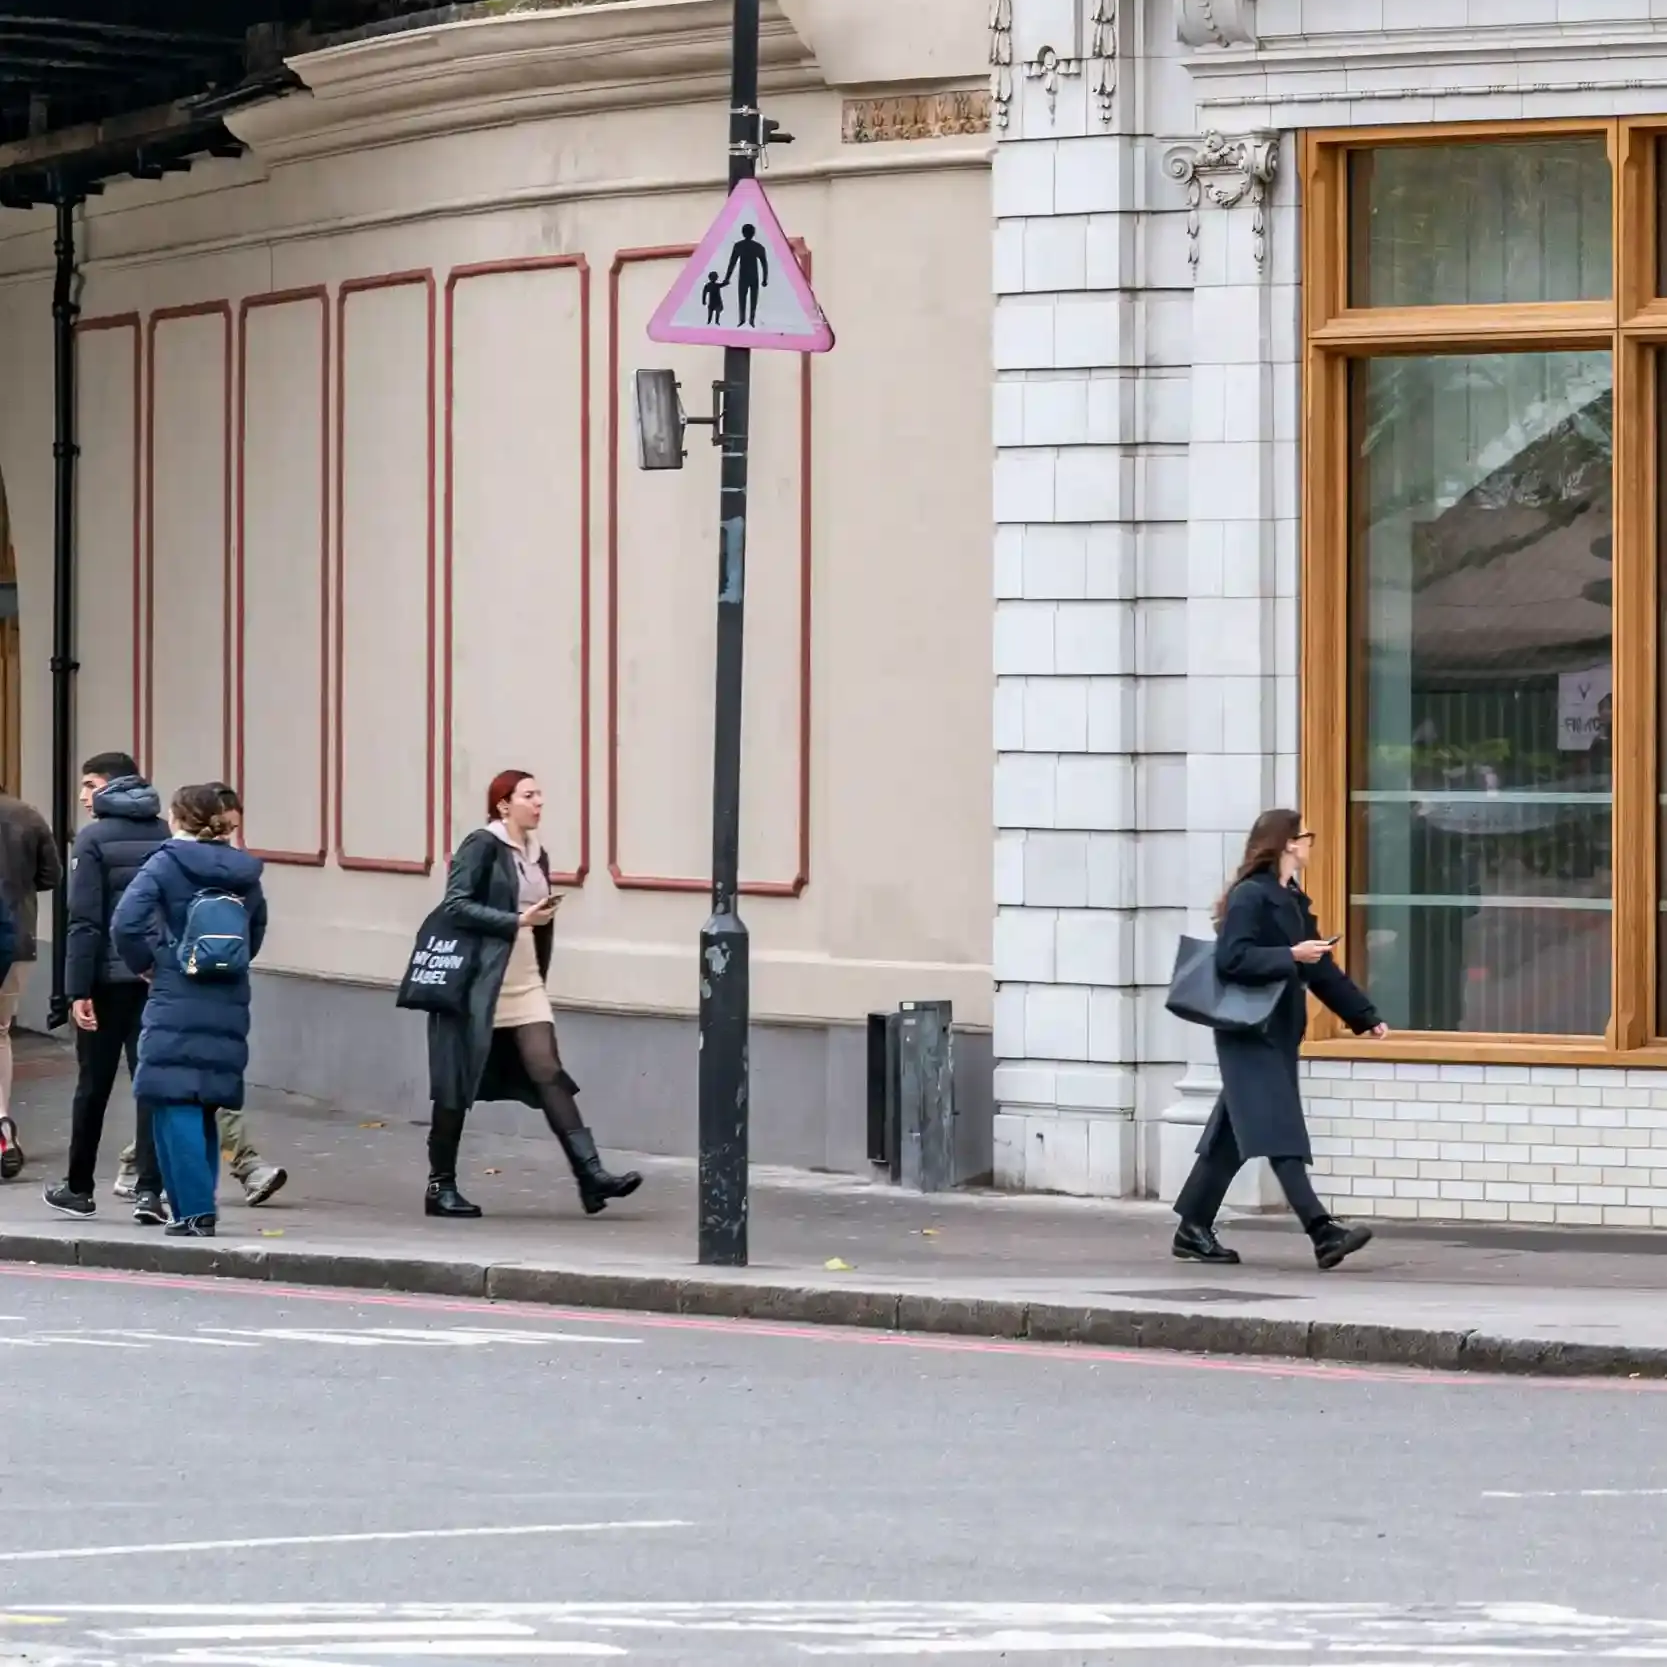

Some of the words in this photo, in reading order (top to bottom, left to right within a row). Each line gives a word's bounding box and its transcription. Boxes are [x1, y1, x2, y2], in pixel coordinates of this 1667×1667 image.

[427, 935, 436, 949] I
[432, 939, 458, 953] AM
[413, 950, 432, 966] MY
[428, 955, 464, 969] OWN
